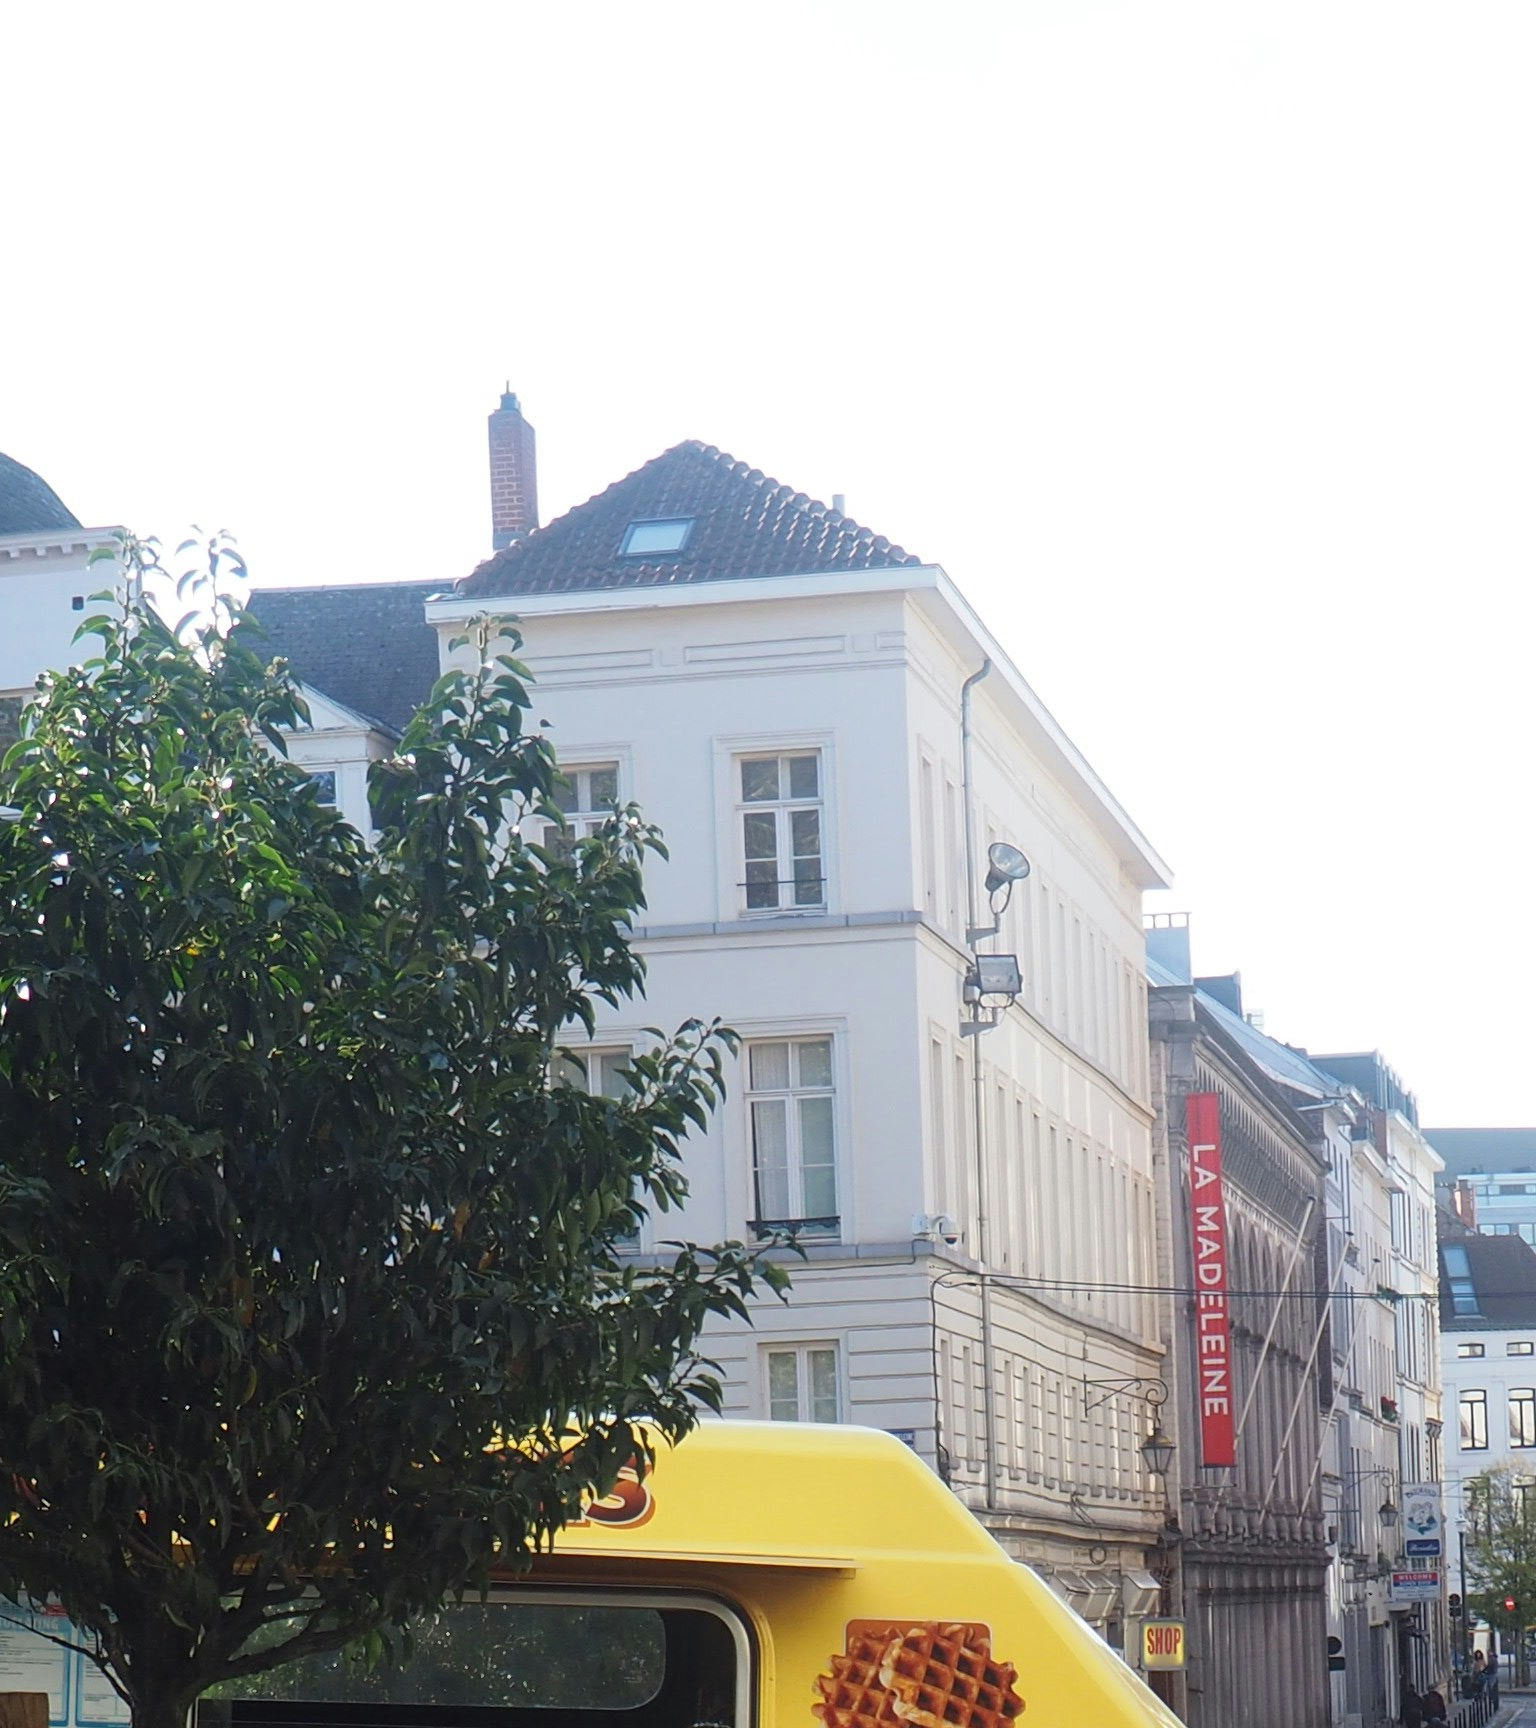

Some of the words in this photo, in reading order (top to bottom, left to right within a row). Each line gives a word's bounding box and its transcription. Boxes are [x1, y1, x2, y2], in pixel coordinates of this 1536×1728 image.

[1193, 1144, 1218, 1190] LA
[1196, 1206, 1229, 1417] MADELEINE
[1147, 1627, 1181, 1655] SHOP
